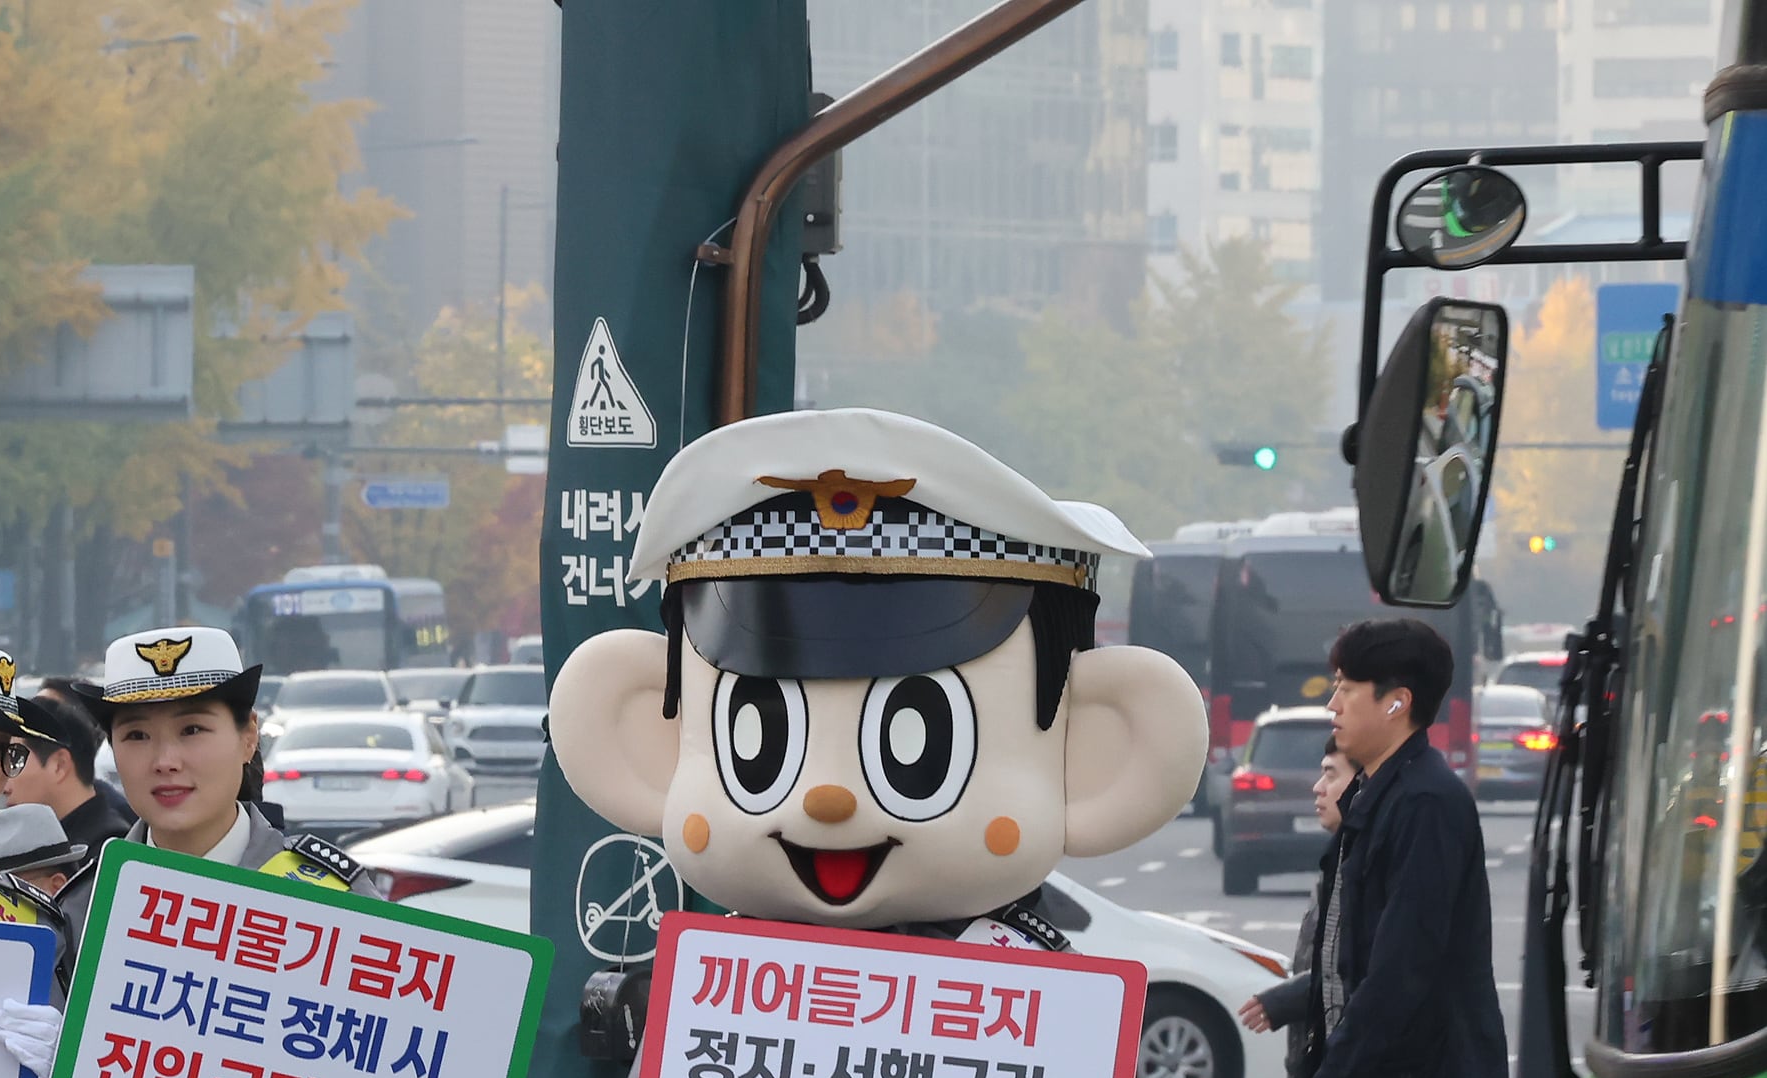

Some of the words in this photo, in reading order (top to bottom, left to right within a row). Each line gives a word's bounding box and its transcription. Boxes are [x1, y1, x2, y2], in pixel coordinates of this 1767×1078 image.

[579, 416, 634, 436] 횡단보도
[126, 885, 340, 986] 꼬리물기
[348, 934, 455, 1012] 금지
[110, 959, 270, 1045] 교차로
[281, 996, 388, 1074] 정체
[692, 955, 917, 1035] 끼어들기
[931, 979, 1042, 1047] 금지
